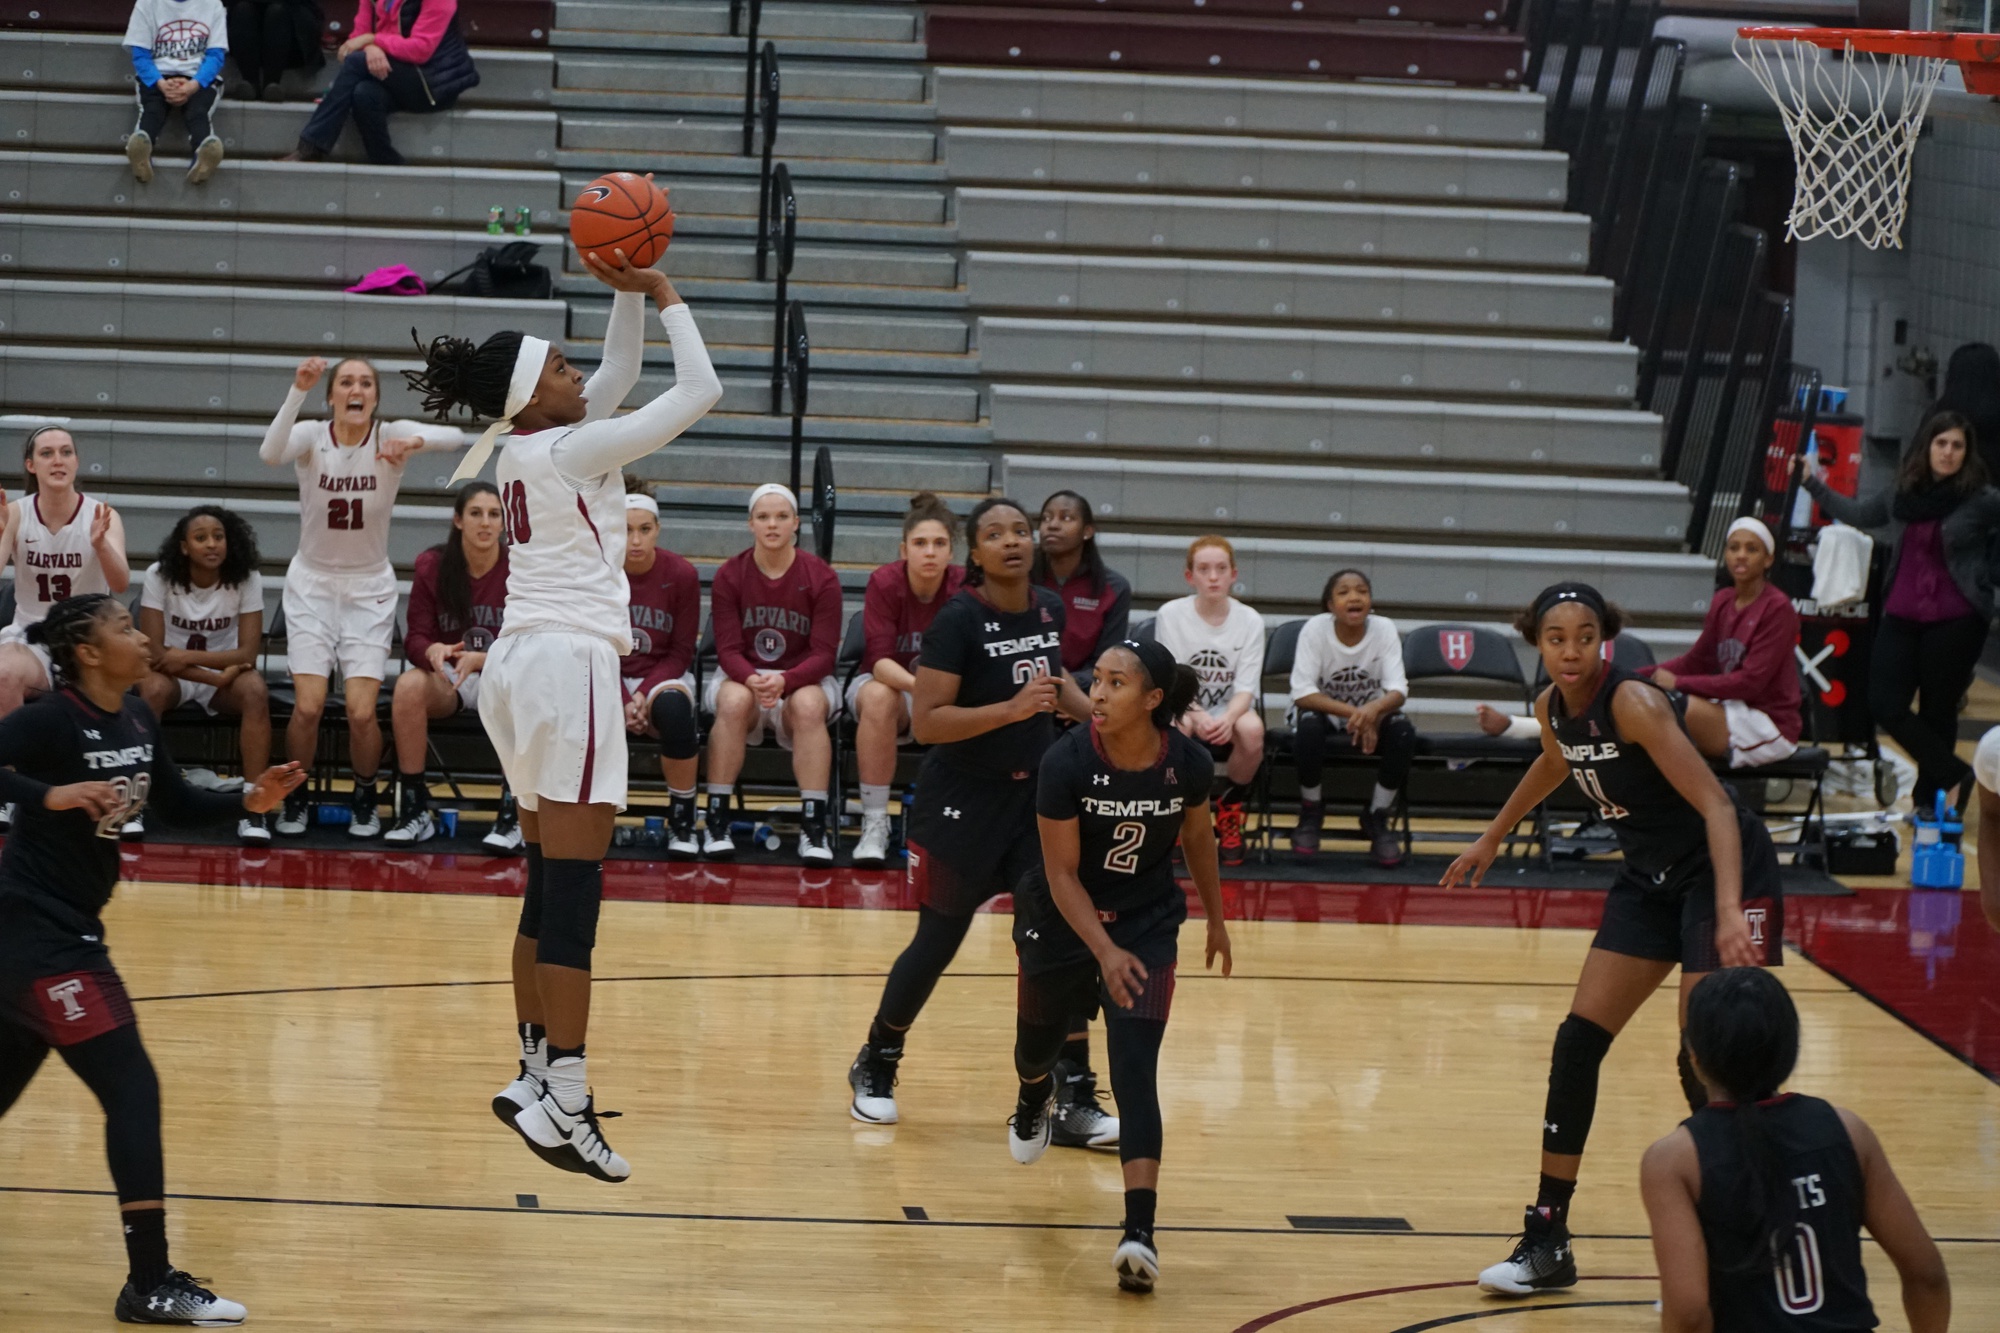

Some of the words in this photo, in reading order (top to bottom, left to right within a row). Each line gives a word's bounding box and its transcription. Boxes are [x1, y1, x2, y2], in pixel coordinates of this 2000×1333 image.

[319, 474, 377, 492] HARVARD
[327, 498, 364, 530] 21
[26, 550, 82, 568] HARVARD
[36, 573, 72, 602] 13
[172, 615, 231, 631] HARVARD
[742, 606, 811, 636] ARVARD
[984, 632, 1060, 657] TEMPLE
[1081, 797, 1184, 817] TEMPLE
[1573, 768, 1630, 820] 11
[1103, 821, 1146, 875] 2
[1769, 1222, 1825, 1315] 0
